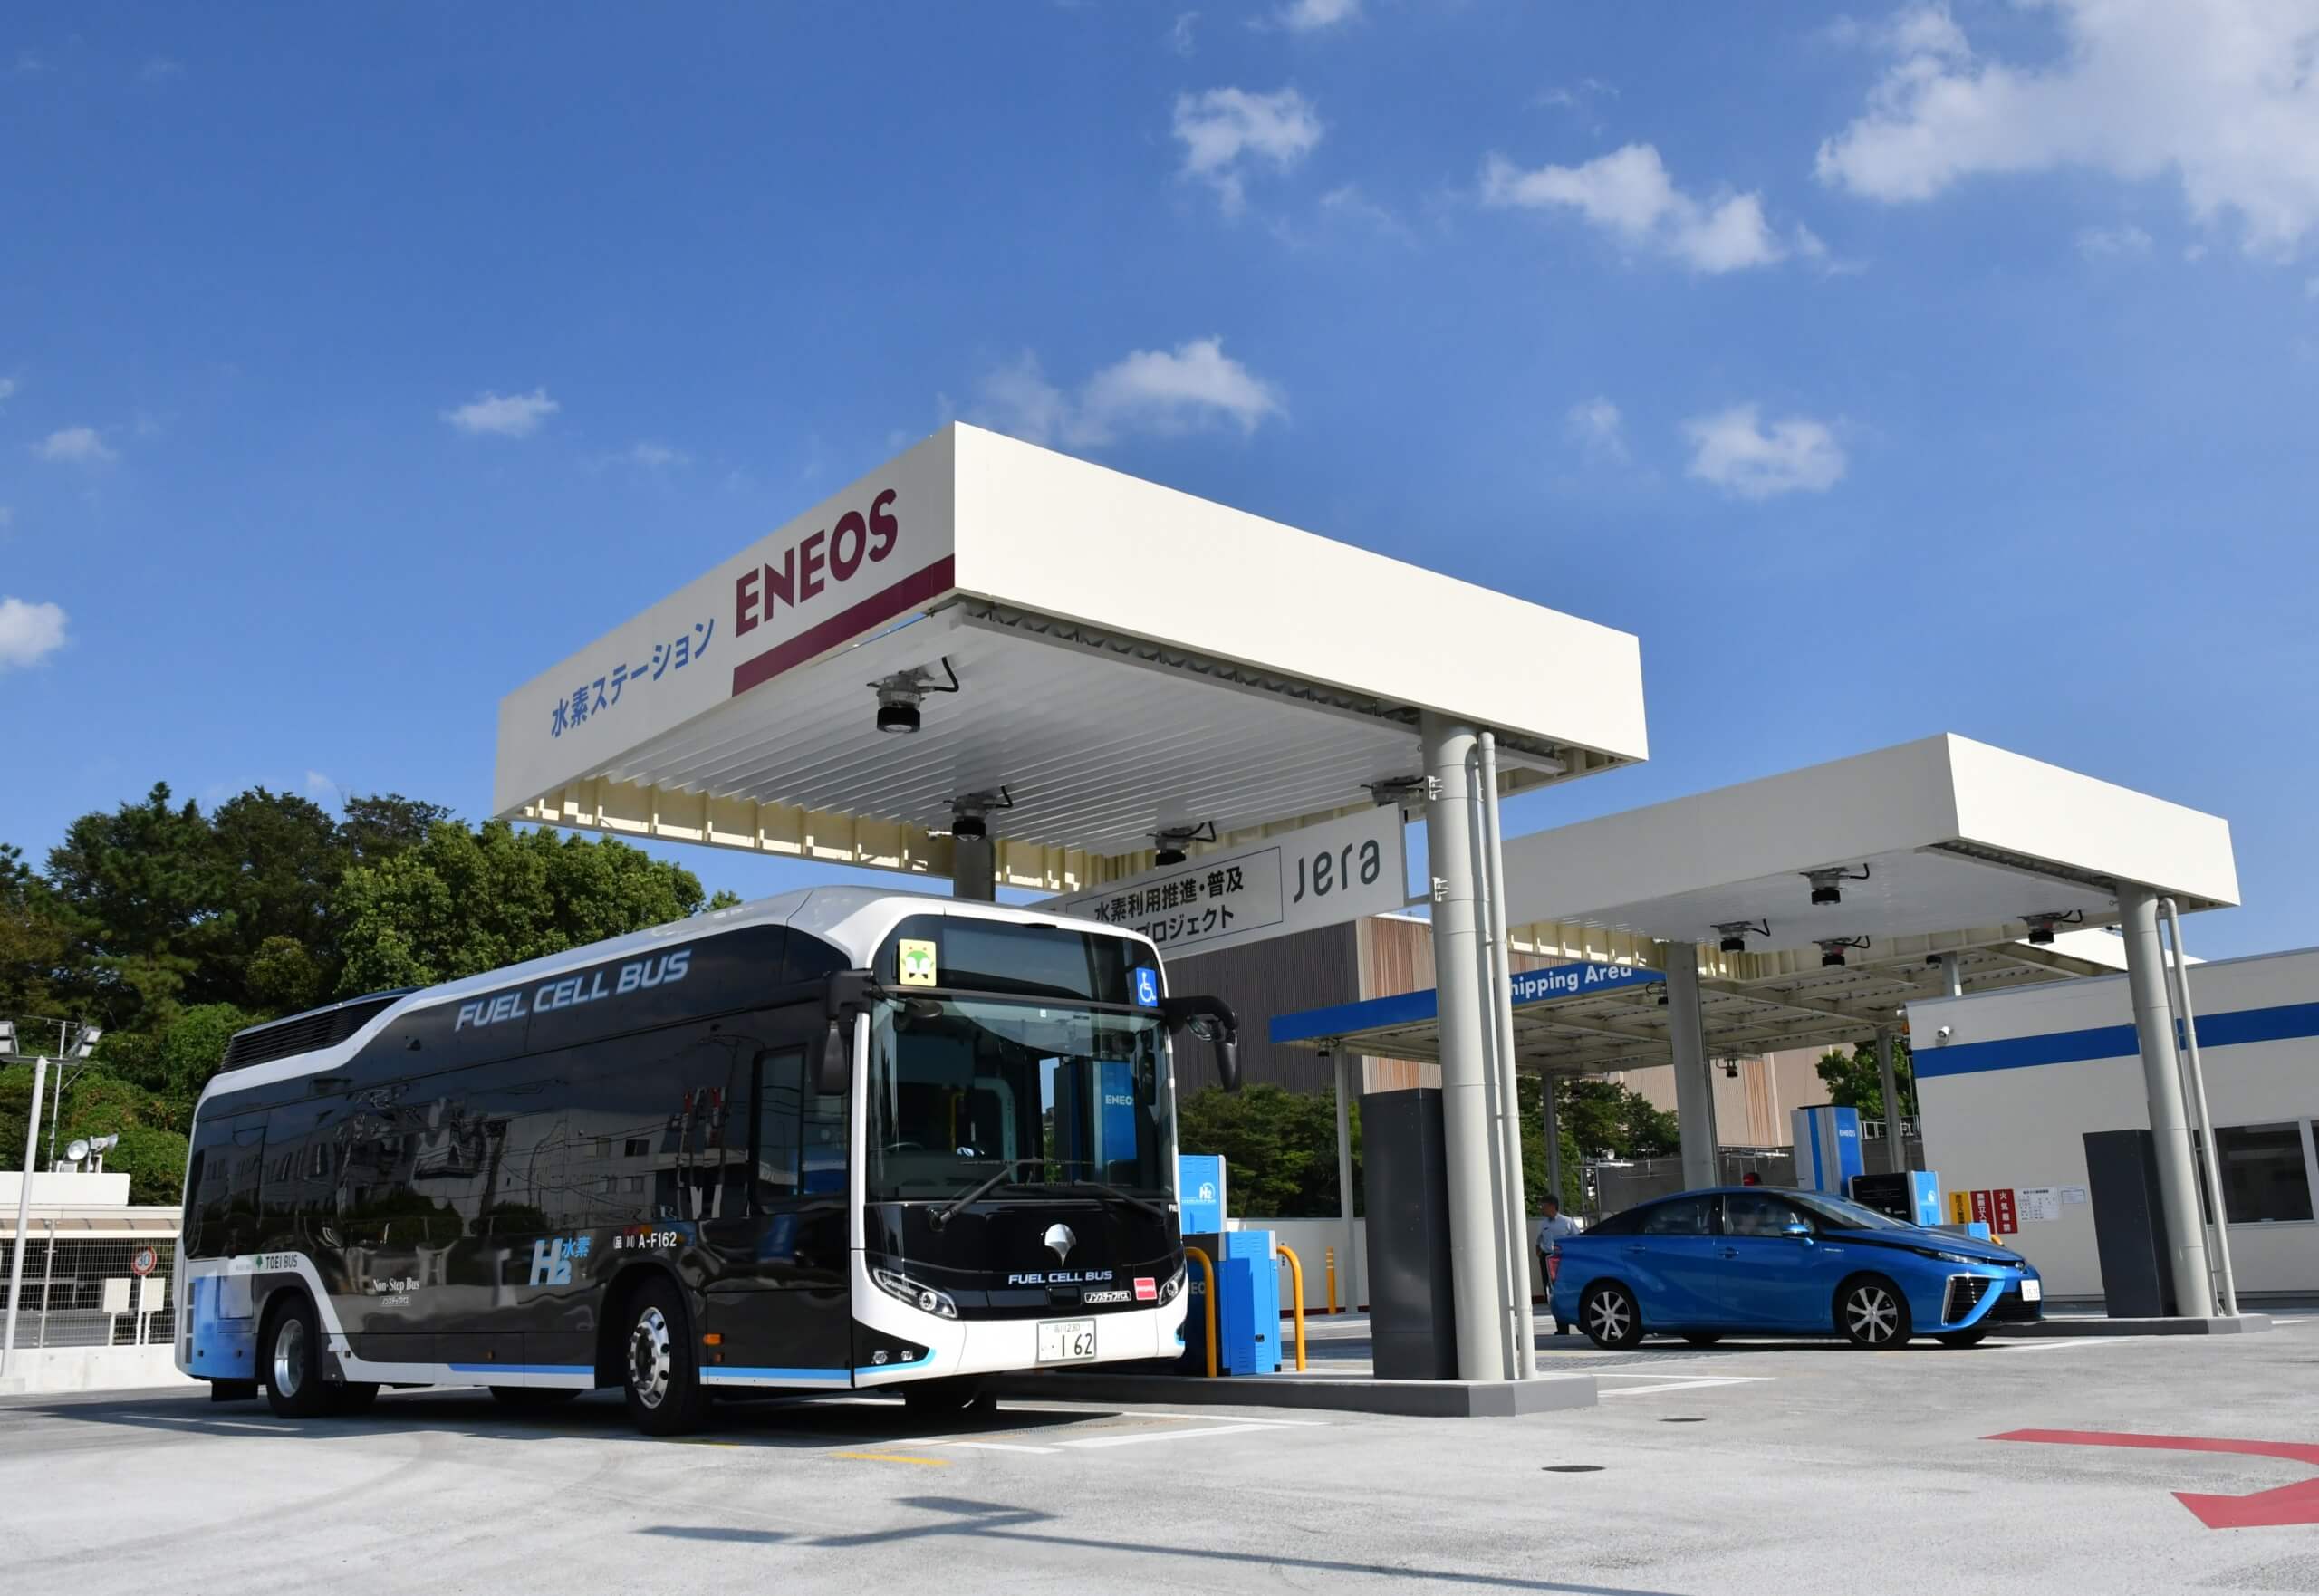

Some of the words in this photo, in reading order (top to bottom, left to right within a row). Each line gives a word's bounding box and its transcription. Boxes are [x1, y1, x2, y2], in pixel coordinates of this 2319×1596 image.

[736, 488, 898, 639] ENEOS
[552, 618, 714, 737] 水素ステーション
[1128, 904, 1234, 943] プロジェクト
[455, 992, 526, 1031] FUEL
[533, 971, 609, 1013] CELL
[616, 950, 692, 994] BUS
[1509, 971, 1578, 998] hipping
[1105, 1094, 1134, 1105] ENEO
[562, 1235, 591, 1258] 水素
[638, 1231, 677, 1249] A-F162
[265, 1255, 282, 1269] TOEI
[284, 1255, 297, 1268] BUS
[529, 1238, 572, 1285] H2
[406, 1277, 419, 1290] Bus
[1008, 1274, 1045, 1284] FUEL
[1048, 1272, 1083, 1283] CELL
[1085, 1271, 1112, 1281] BUS
